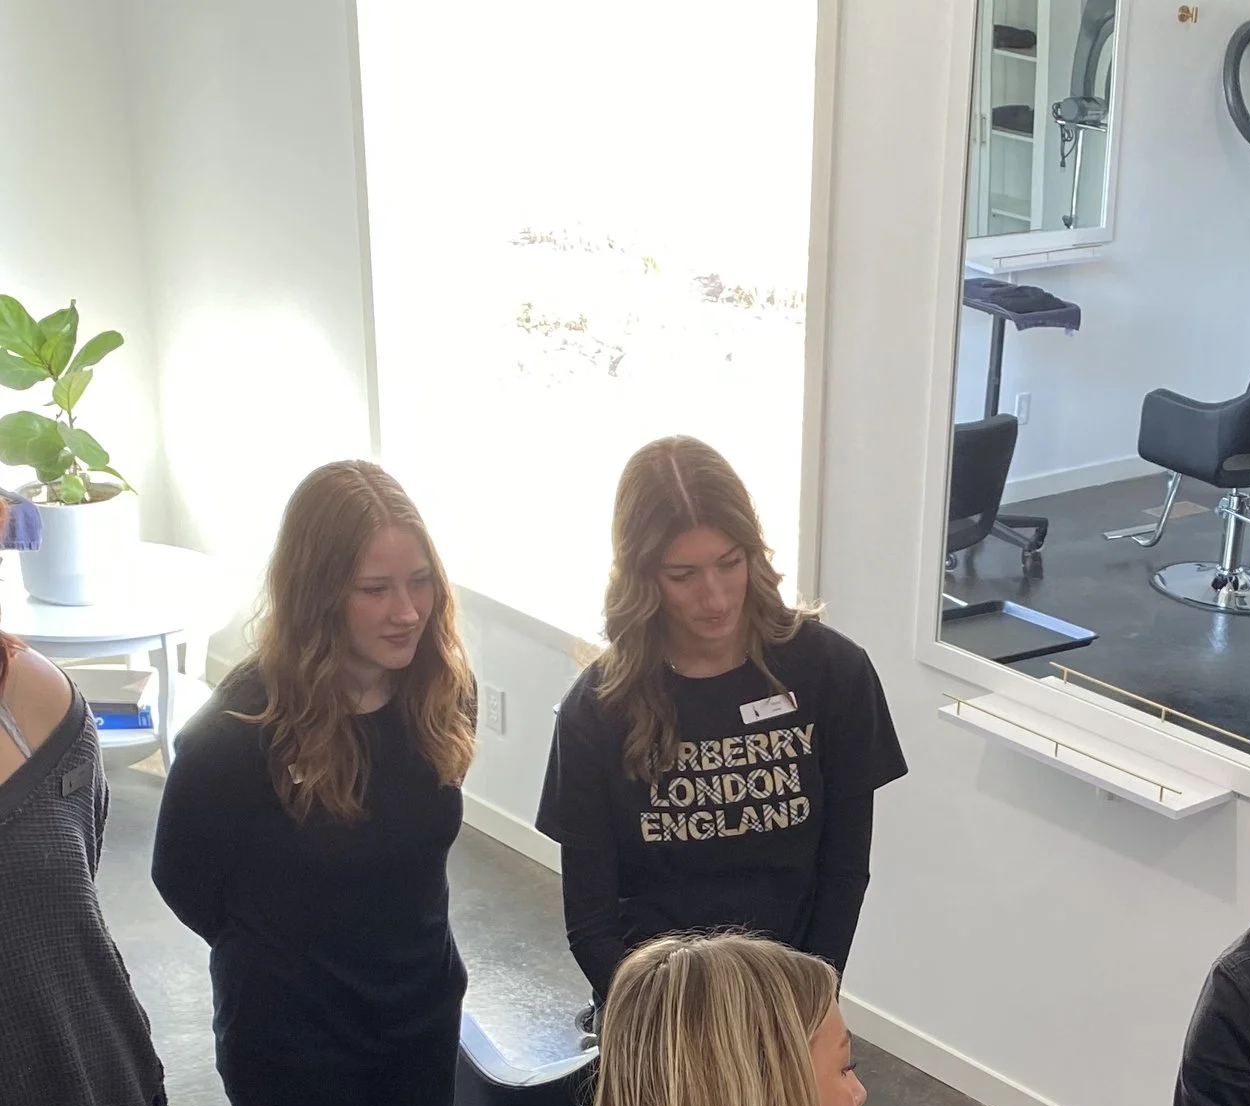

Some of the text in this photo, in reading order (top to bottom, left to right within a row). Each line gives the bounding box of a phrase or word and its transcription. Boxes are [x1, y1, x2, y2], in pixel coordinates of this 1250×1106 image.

[650, 722, 815, 776] RBERRY
[650, 763, 801, 807] LONDON
[640, 796, 810, 842] ENGLAND
